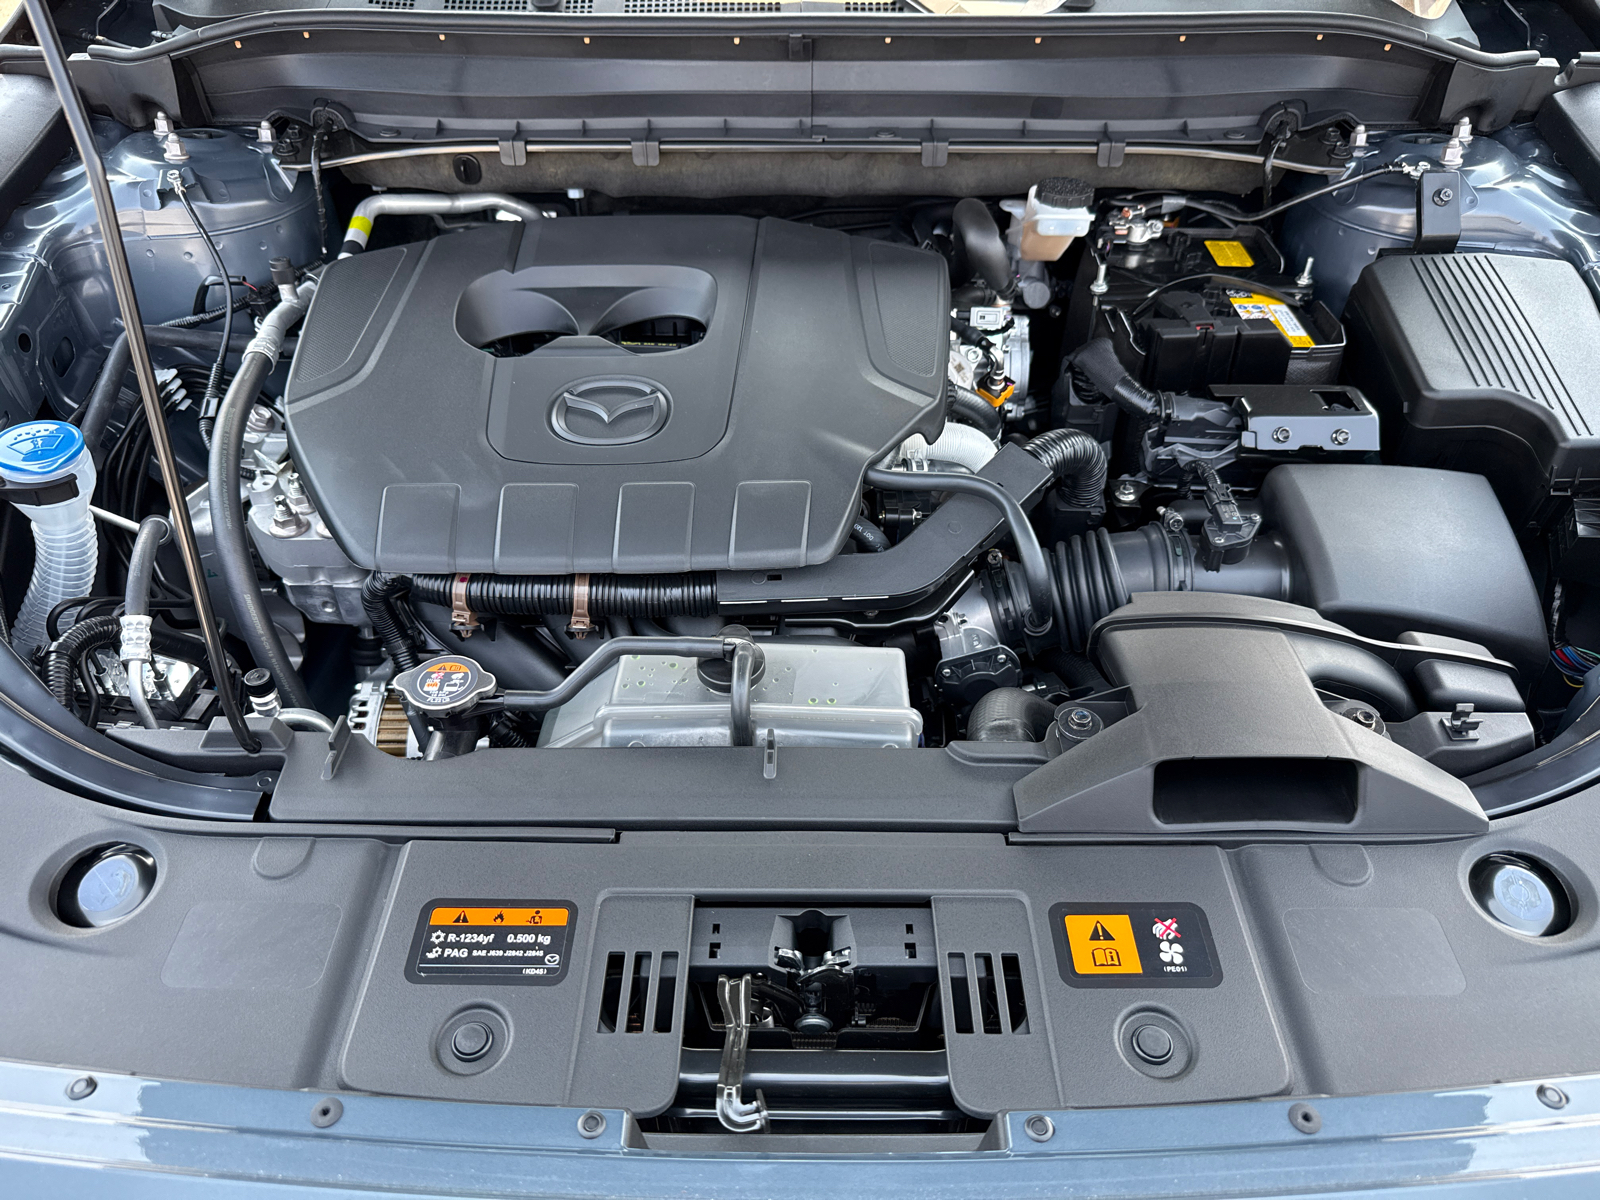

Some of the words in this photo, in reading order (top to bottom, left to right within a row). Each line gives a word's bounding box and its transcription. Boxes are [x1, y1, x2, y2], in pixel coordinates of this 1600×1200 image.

[243, 594, 264, 635] BRIDGESTONE
[447, 933, 495, 945] R-1234yf
[506, 933, 536, 943] 0.500
[537, 934, 551, 945] kg
[443, 948, 468, 958] PAG
[472, 949, 487, 957] SAE
